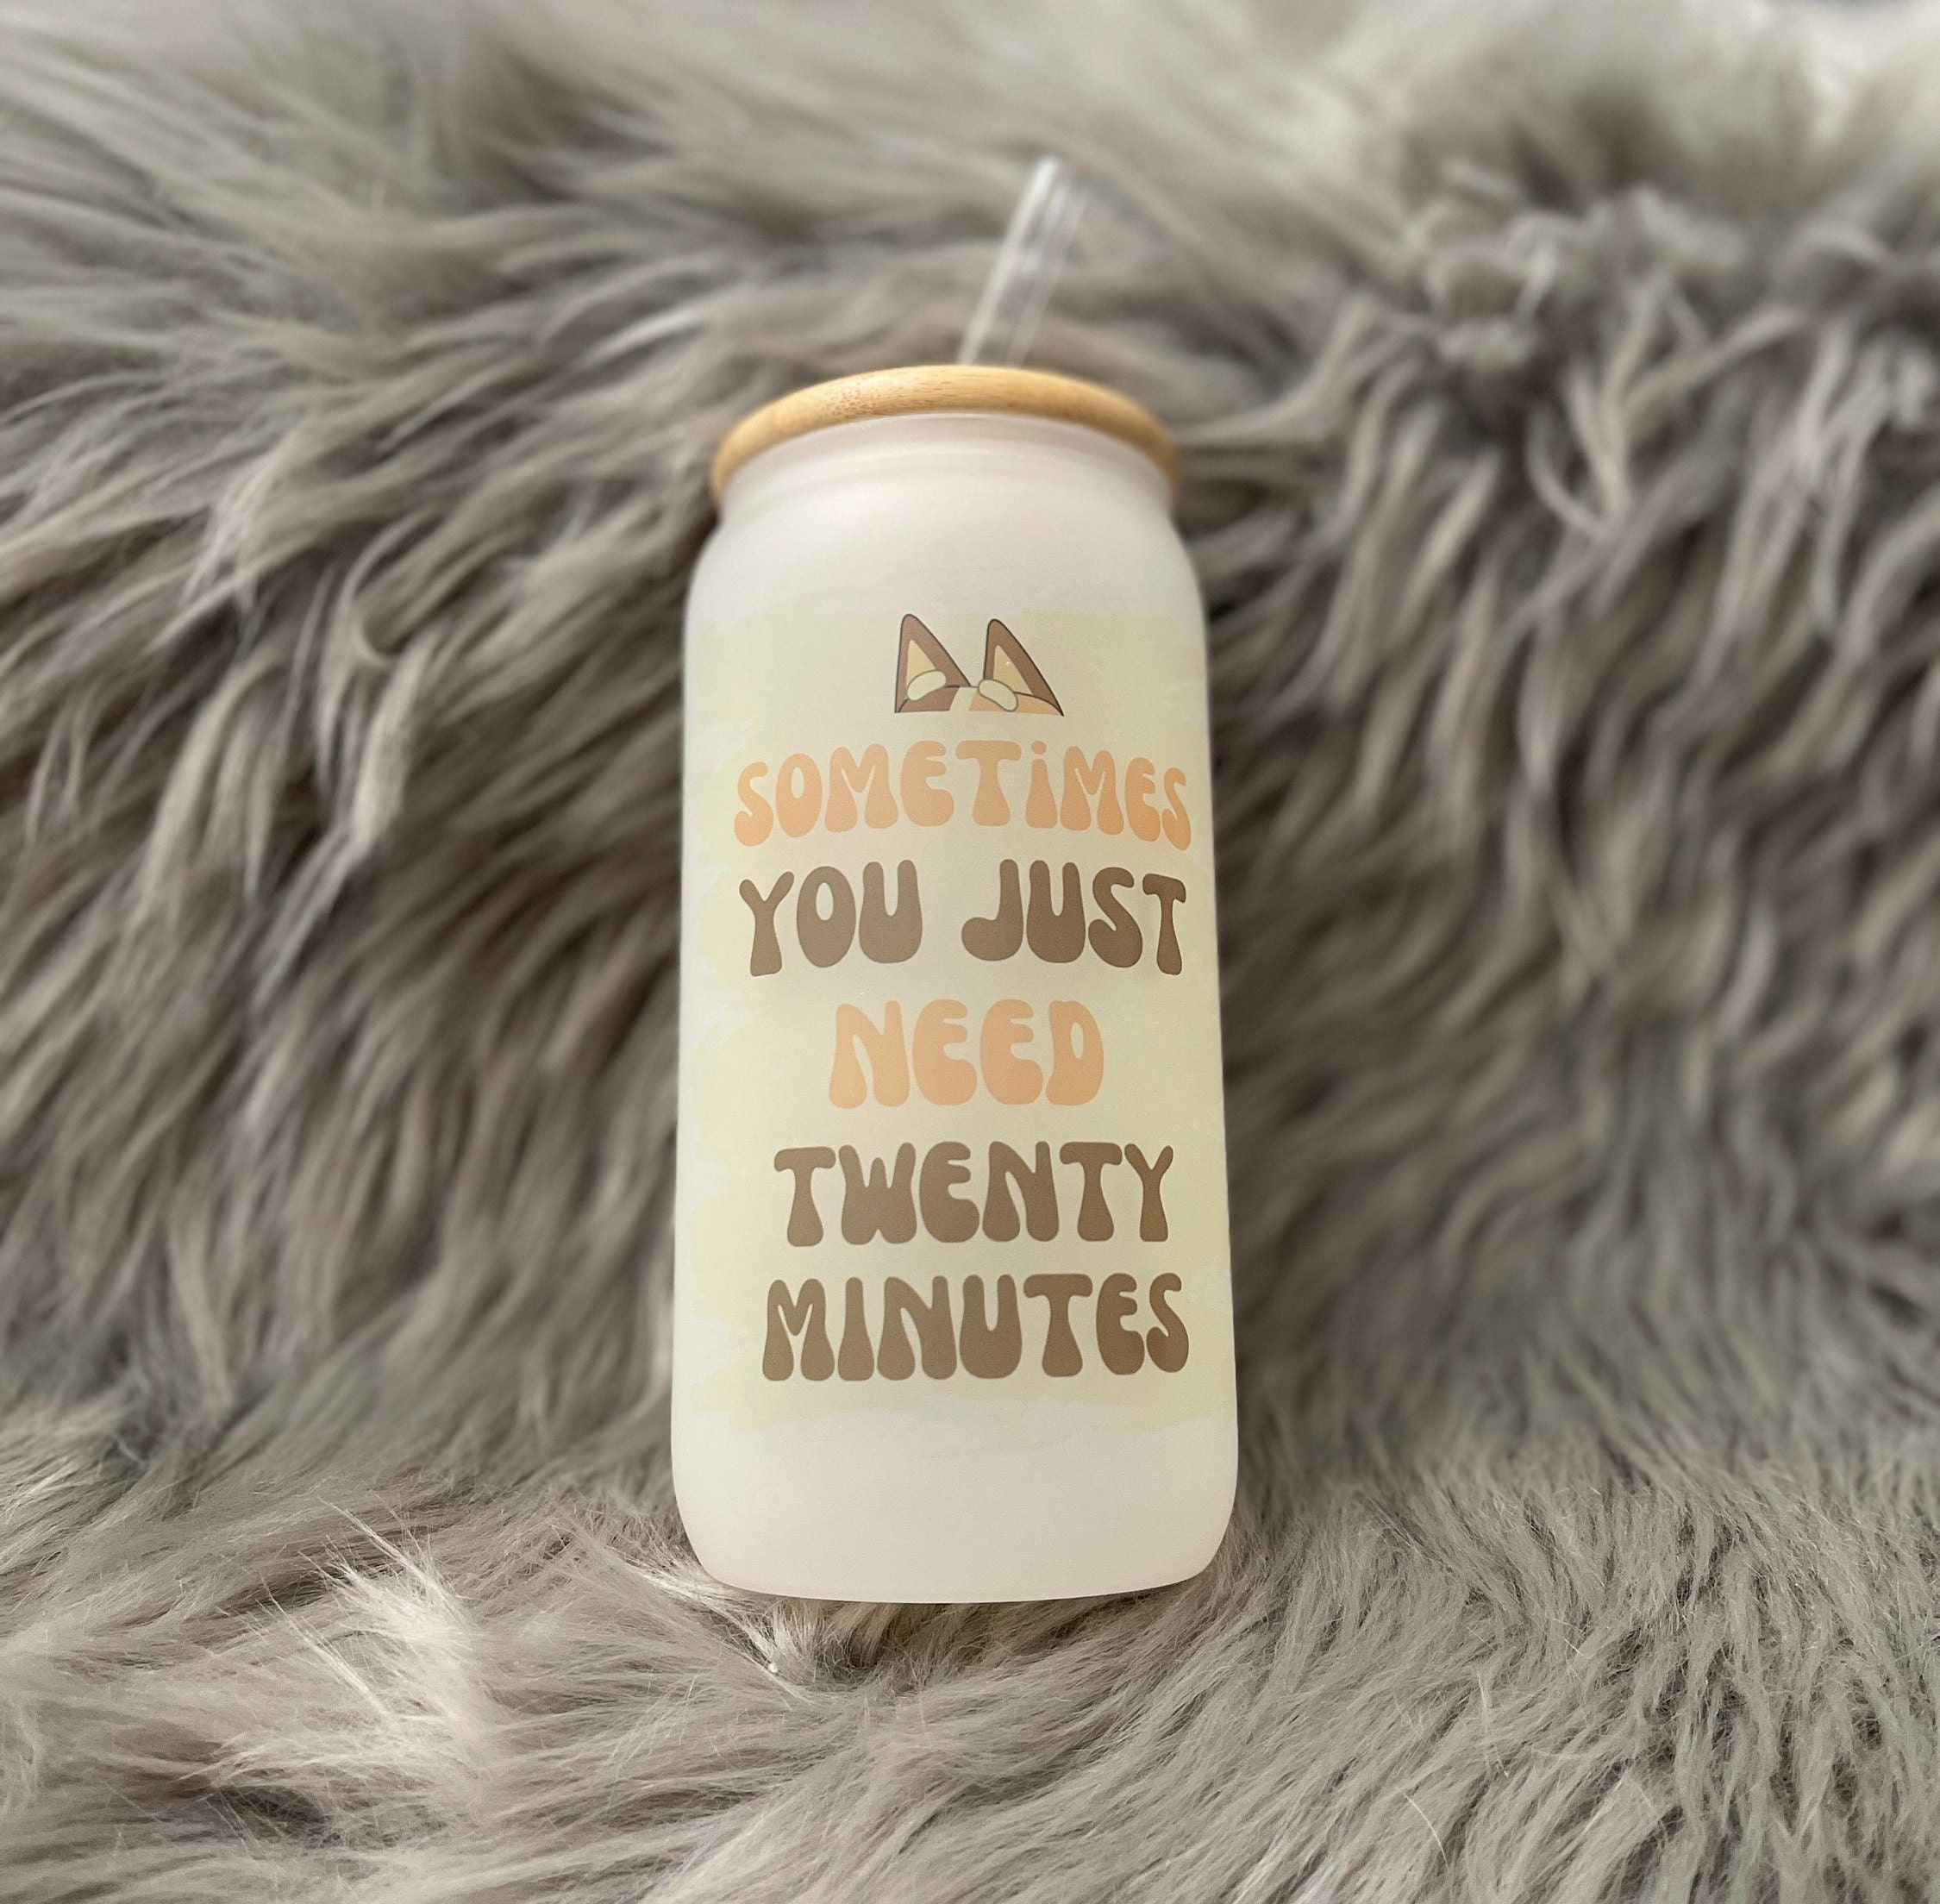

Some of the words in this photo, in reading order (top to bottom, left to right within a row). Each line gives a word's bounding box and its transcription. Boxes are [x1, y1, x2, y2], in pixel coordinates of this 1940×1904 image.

[739, 859, 923, 977] YOU
[961, 859, 1187, 976] JUST
[829, 999, 1105, 1109] NEED
[773, 1141, 1174, 1248] TWENTY
[762, 1272, 1190, 1381] MINUTES
